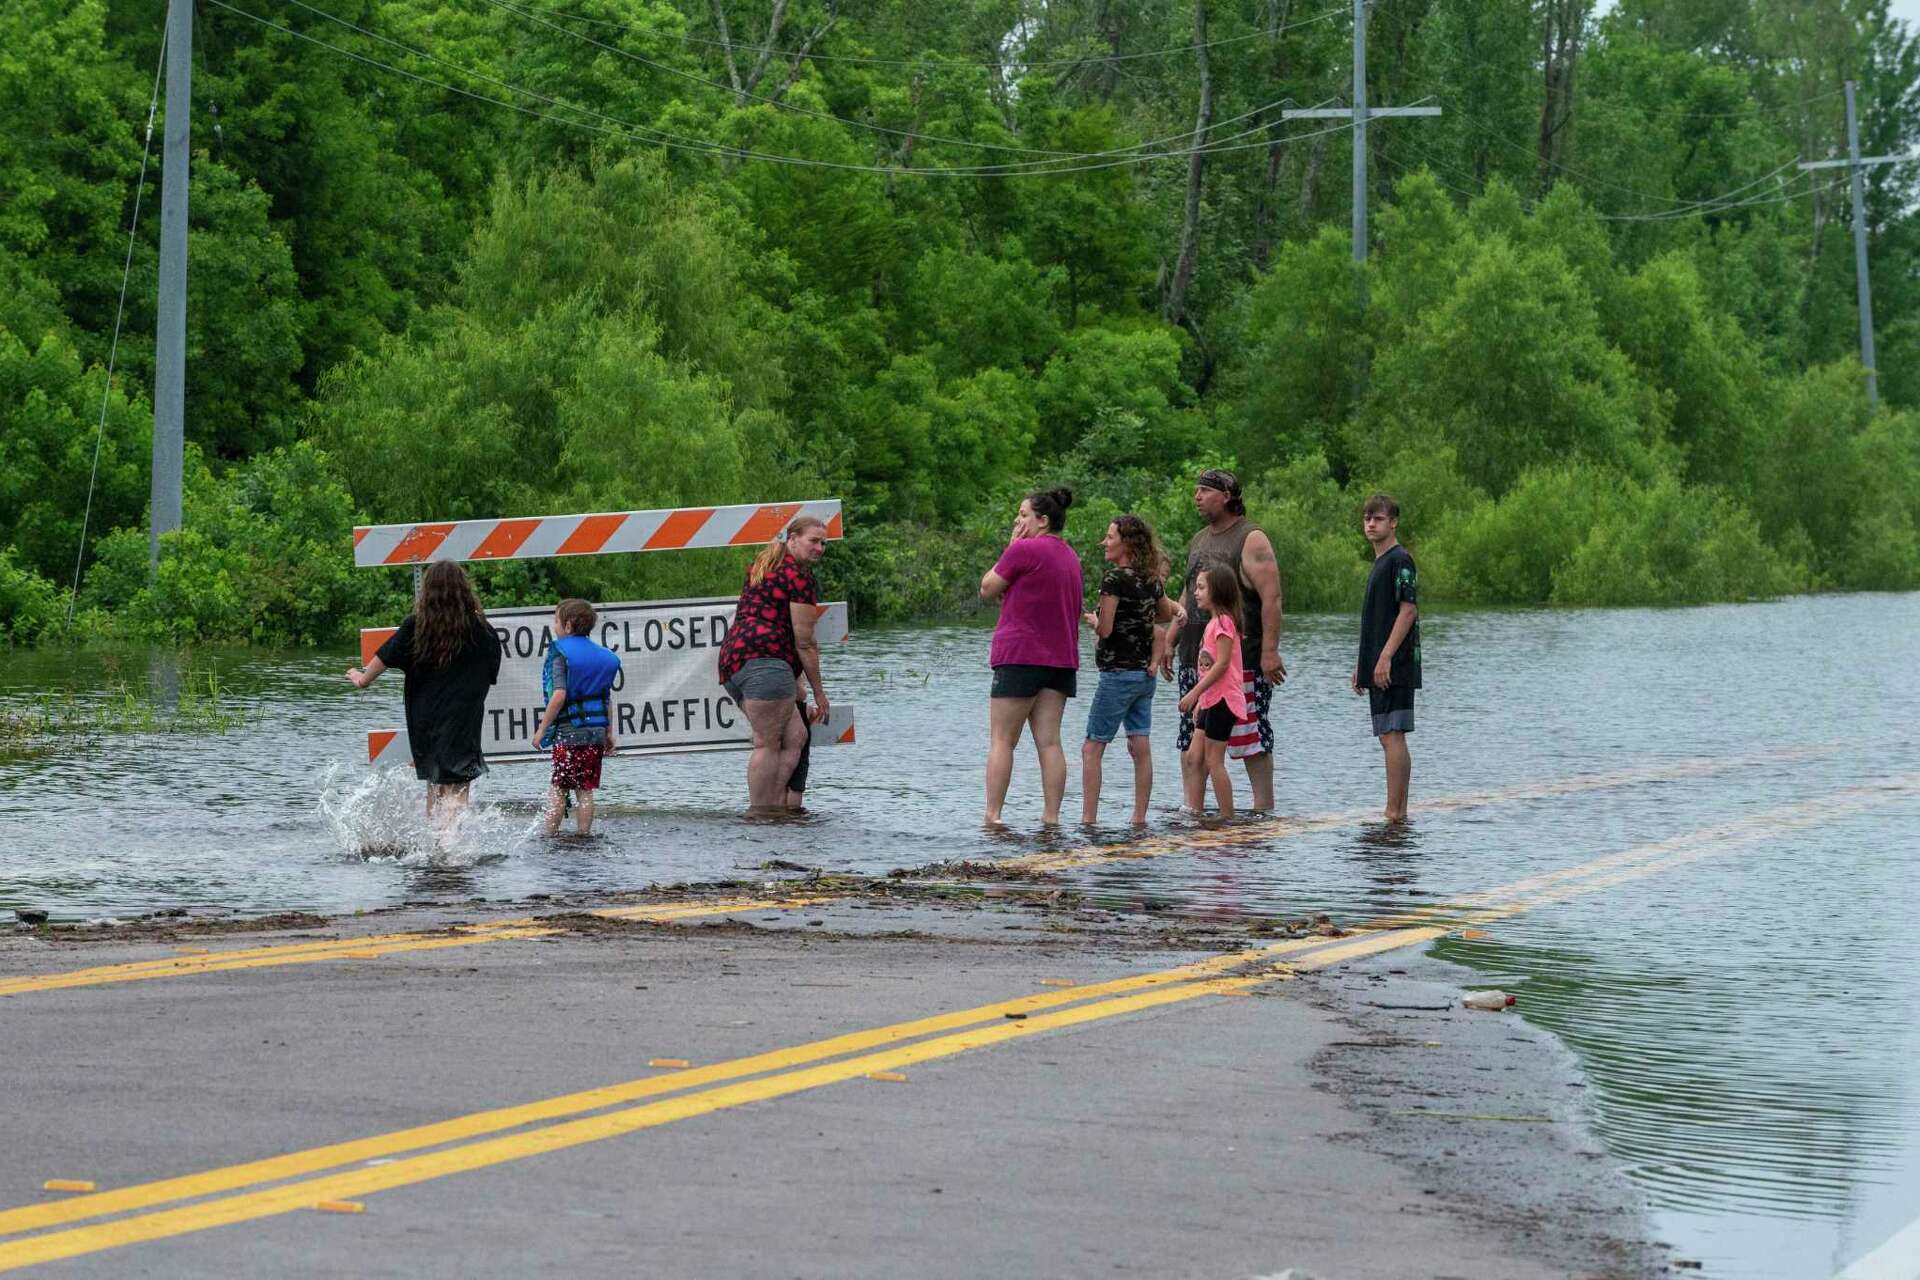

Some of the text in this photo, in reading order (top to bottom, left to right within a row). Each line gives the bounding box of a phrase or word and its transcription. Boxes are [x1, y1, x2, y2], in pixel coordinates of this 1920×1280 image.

[495, 615, 729, 658] ROA CLOSED
[617, 696, 735, 735] RAFFIC
